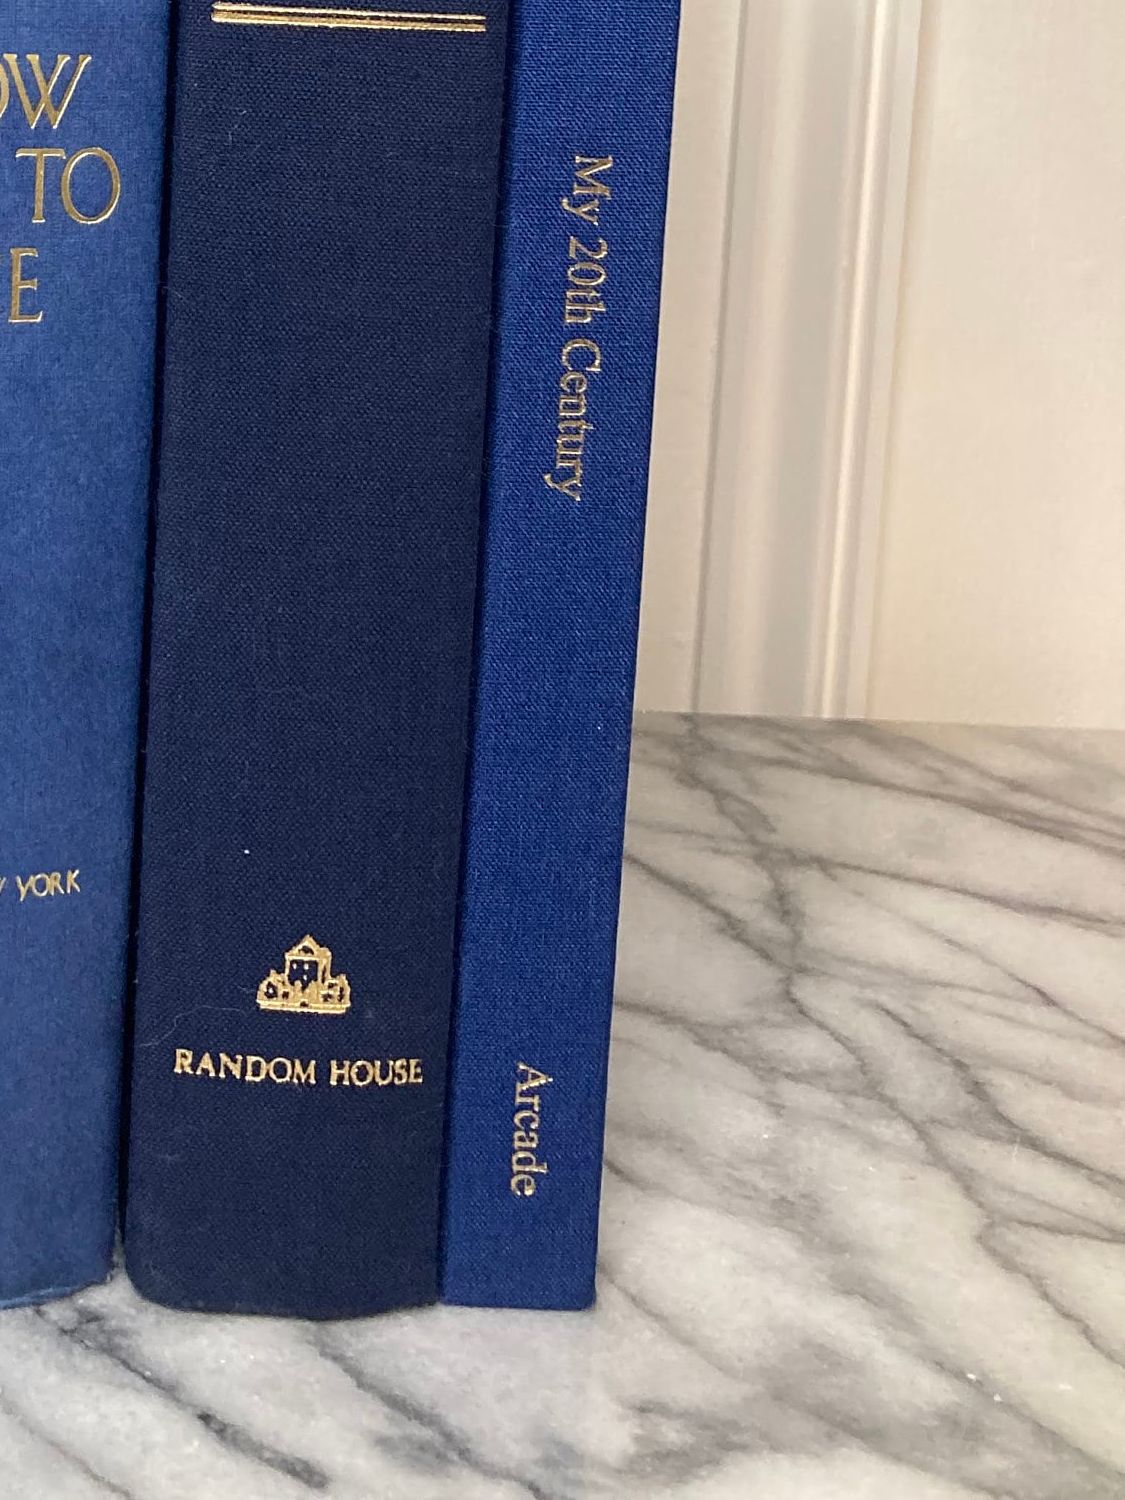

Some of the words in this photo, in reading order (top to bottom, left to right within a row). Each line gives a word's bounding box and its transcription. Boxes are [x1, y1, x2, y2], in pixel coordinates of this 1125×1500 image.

[14, 146, 121, 225] TO
[561, 155, 614, 226] My
[564, 235, 610, 325] 20th
[544, 337, 602, 502] Century
[15, 868, 81, 902] YORK
[173, 1048, 317, 1086] RANDOM
[329, 1057, 424, 1087] HOUSE
[510, 1061, 554, 1198] Arcade
